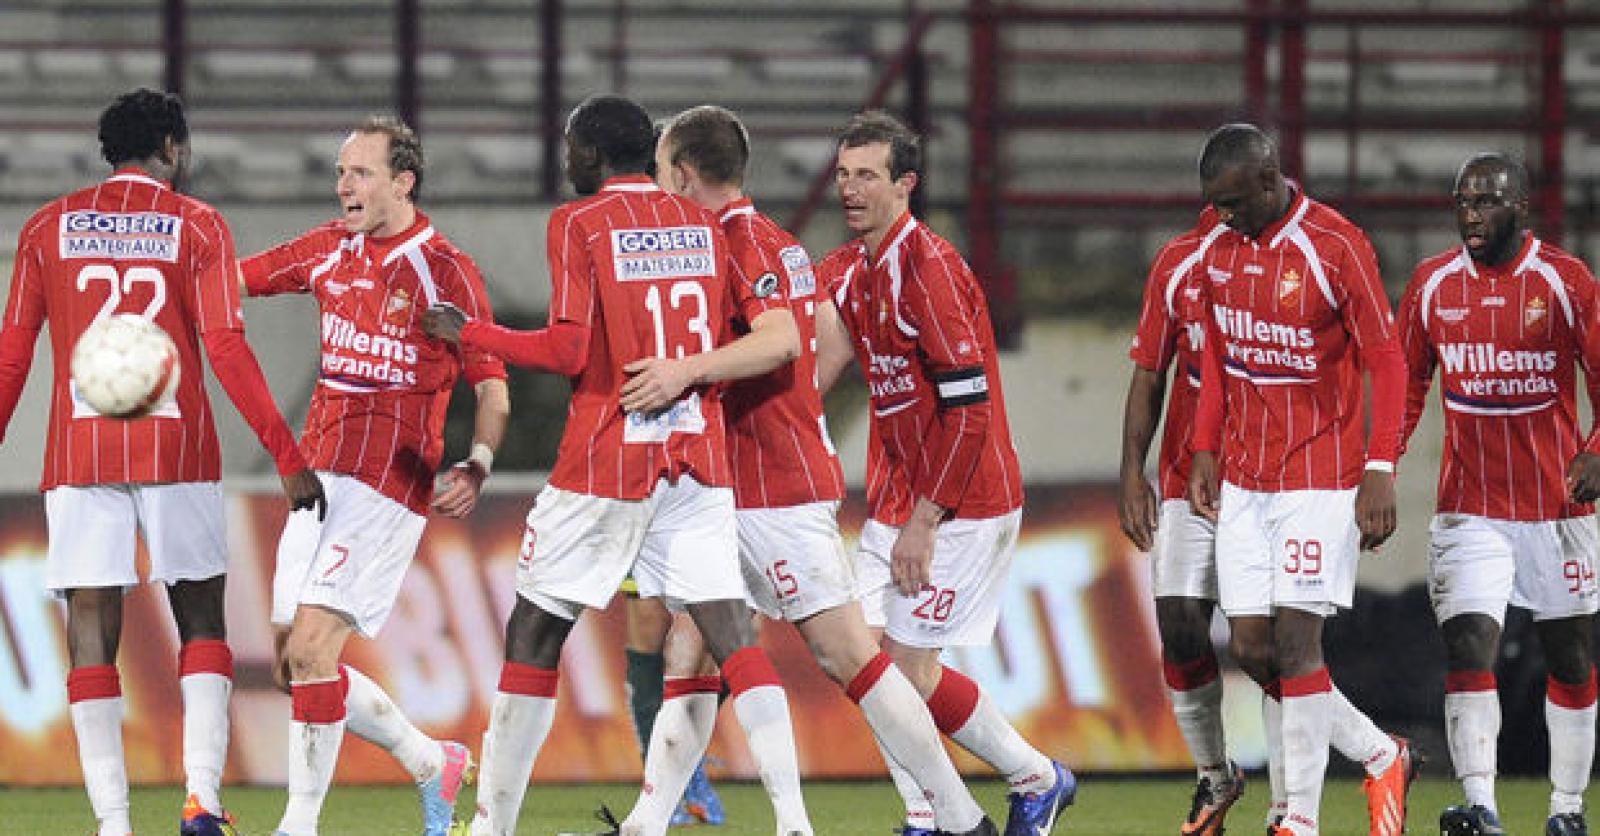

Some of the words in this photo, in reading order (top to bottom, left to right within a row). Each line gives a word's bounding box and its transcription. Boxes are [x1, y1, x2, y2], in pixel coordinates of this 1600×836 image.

[66, 213, 175, 234] GOBERT
[619, 229, 707, 252] GOBERT
[644, 280, 712, 360] 13
[1438, 342, 1557, 374] Willems
[1460, 372, 1559, 396] vérandas
[322, 543, 349, 579] 7
[1282, 538, 1322, 576] 39
[765, 559, 799, 600] 15
[1563, 559, 1597, 594] 94
[910, 583, 956, 623] 20
